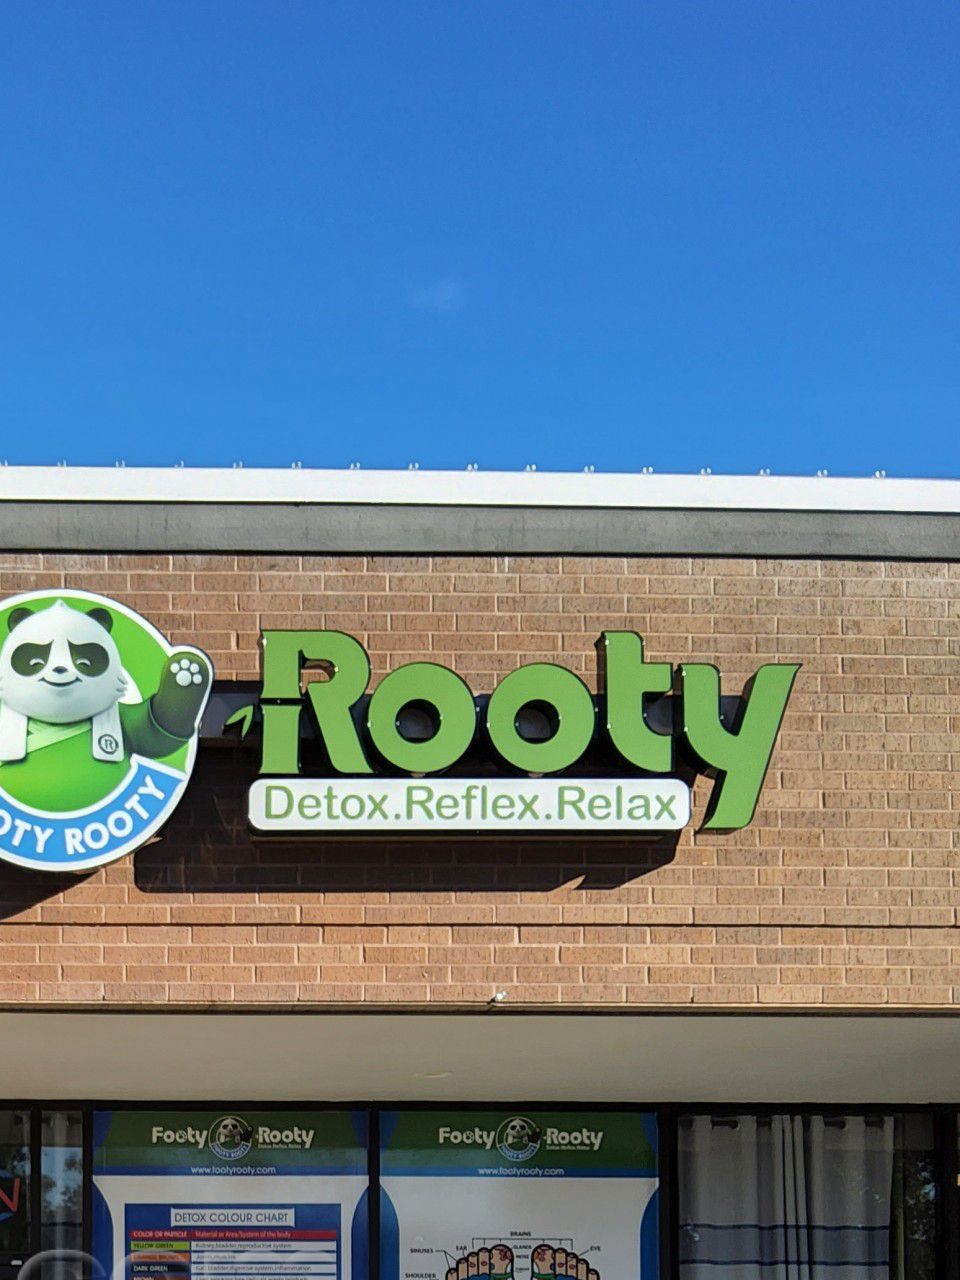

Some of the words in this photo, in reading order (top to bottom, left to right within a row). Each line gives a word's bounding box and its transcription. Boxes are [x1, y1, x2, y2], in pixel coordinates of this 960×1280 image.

[259, 629, 803, 831] Rooty
[64, 774, 166, 855] ROOTY
[265, 785, 677, 821] Detox.Reflex.Relax
[152, 1126, 208, 1149] Footy
[257, 1126, 315, 1149] Rooty
[438, 1127, 496, 1150] Footy
[546, 1127, 604, 1151] Rooty
[191, 1165, 276, 1175] www.footyrooty.com
[478, 1167, 565, 1176] www.footyrooty.com
[174, 1212, 206, 1223] DETOX
[209, 1212, 253, 1223] COLOUR
[255, 1212, 289, 1223] CHART
